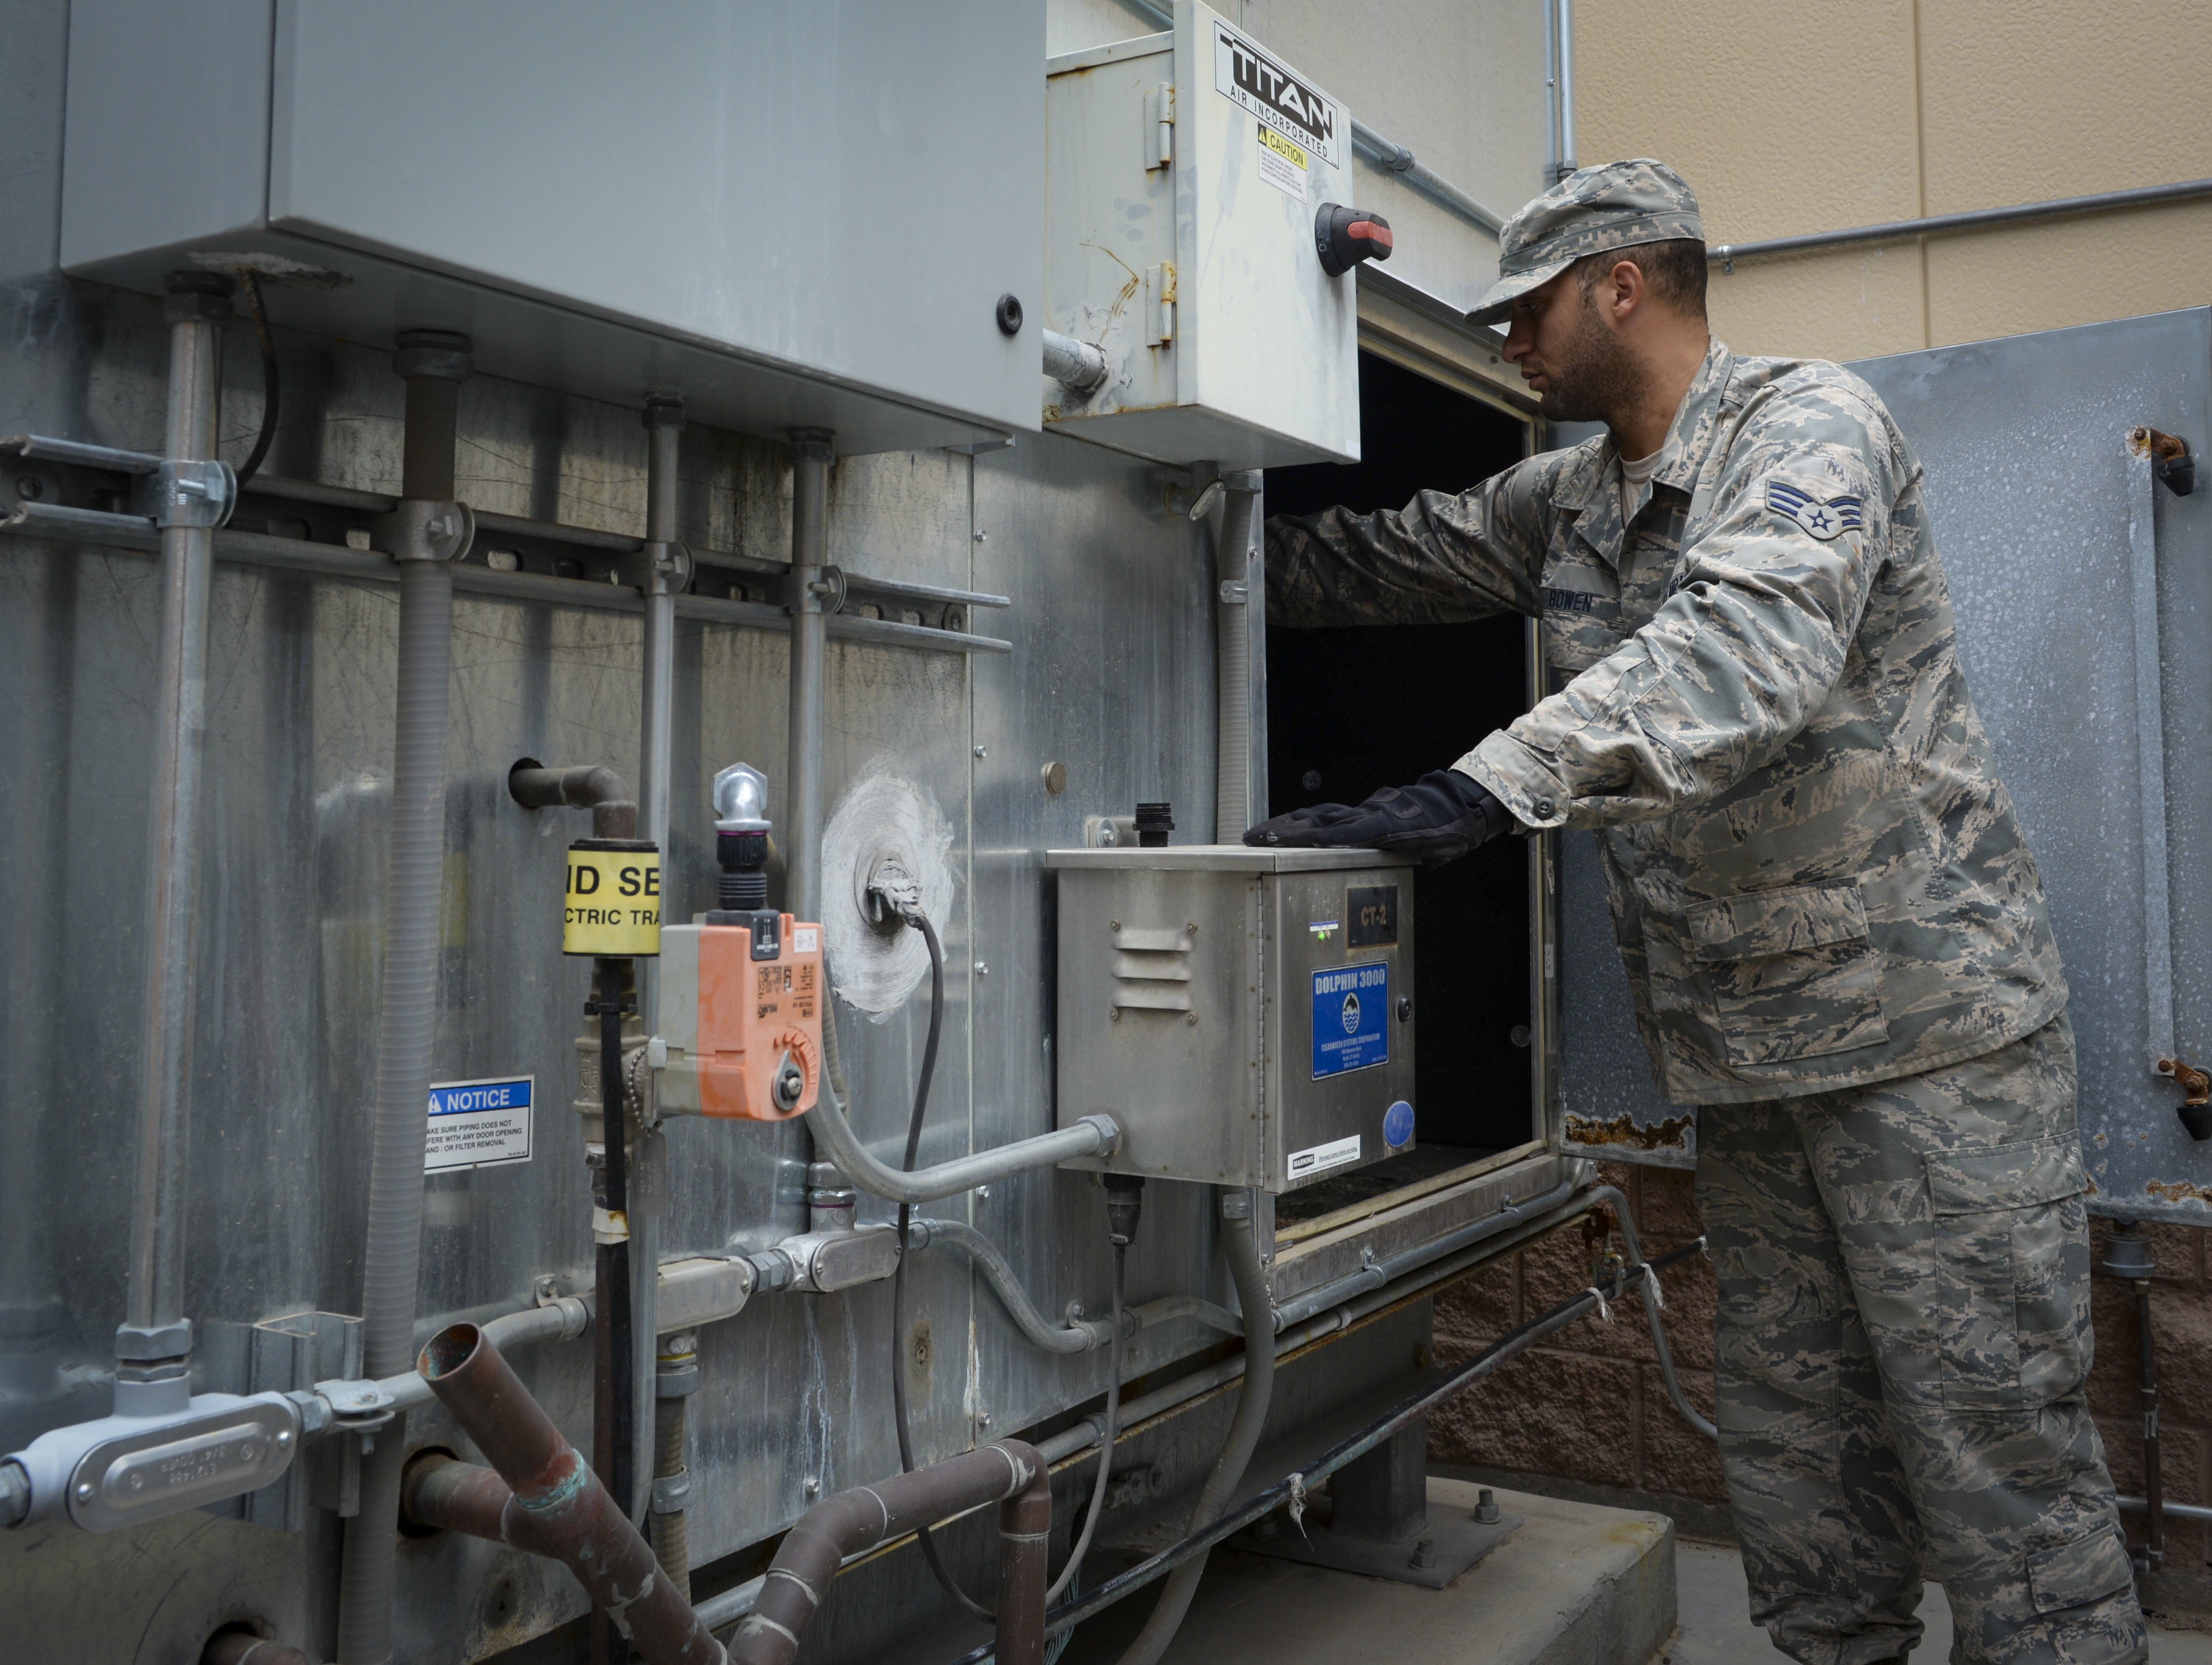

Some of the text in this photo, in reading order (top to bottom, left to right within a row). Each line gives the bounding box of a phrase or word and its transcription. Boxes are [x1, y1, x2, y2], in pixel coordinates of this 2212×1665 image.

[1220, 33, 1332, 142] TITAN
[1231, 86, 1327, 157] AIR INCORPORATED
[1271, 135, 1303, 165] CAUTION
[1550, 591, 1593, 612] BOWEN
[1361, 906, 1386, 926] CT-2
[1315, 968, 1385, 995] DOLPHIN 3000
[1321, 1041, 1343, 1051] CLEARWATER
[1343, 1038, 1358, 1047] SYSTEMS
[1358, 1033, 1380, 1044] CORPORATION
[447, 1089, 510, 1111] NOTICE
[1293, 1155, 1314, 1168] WARNING
